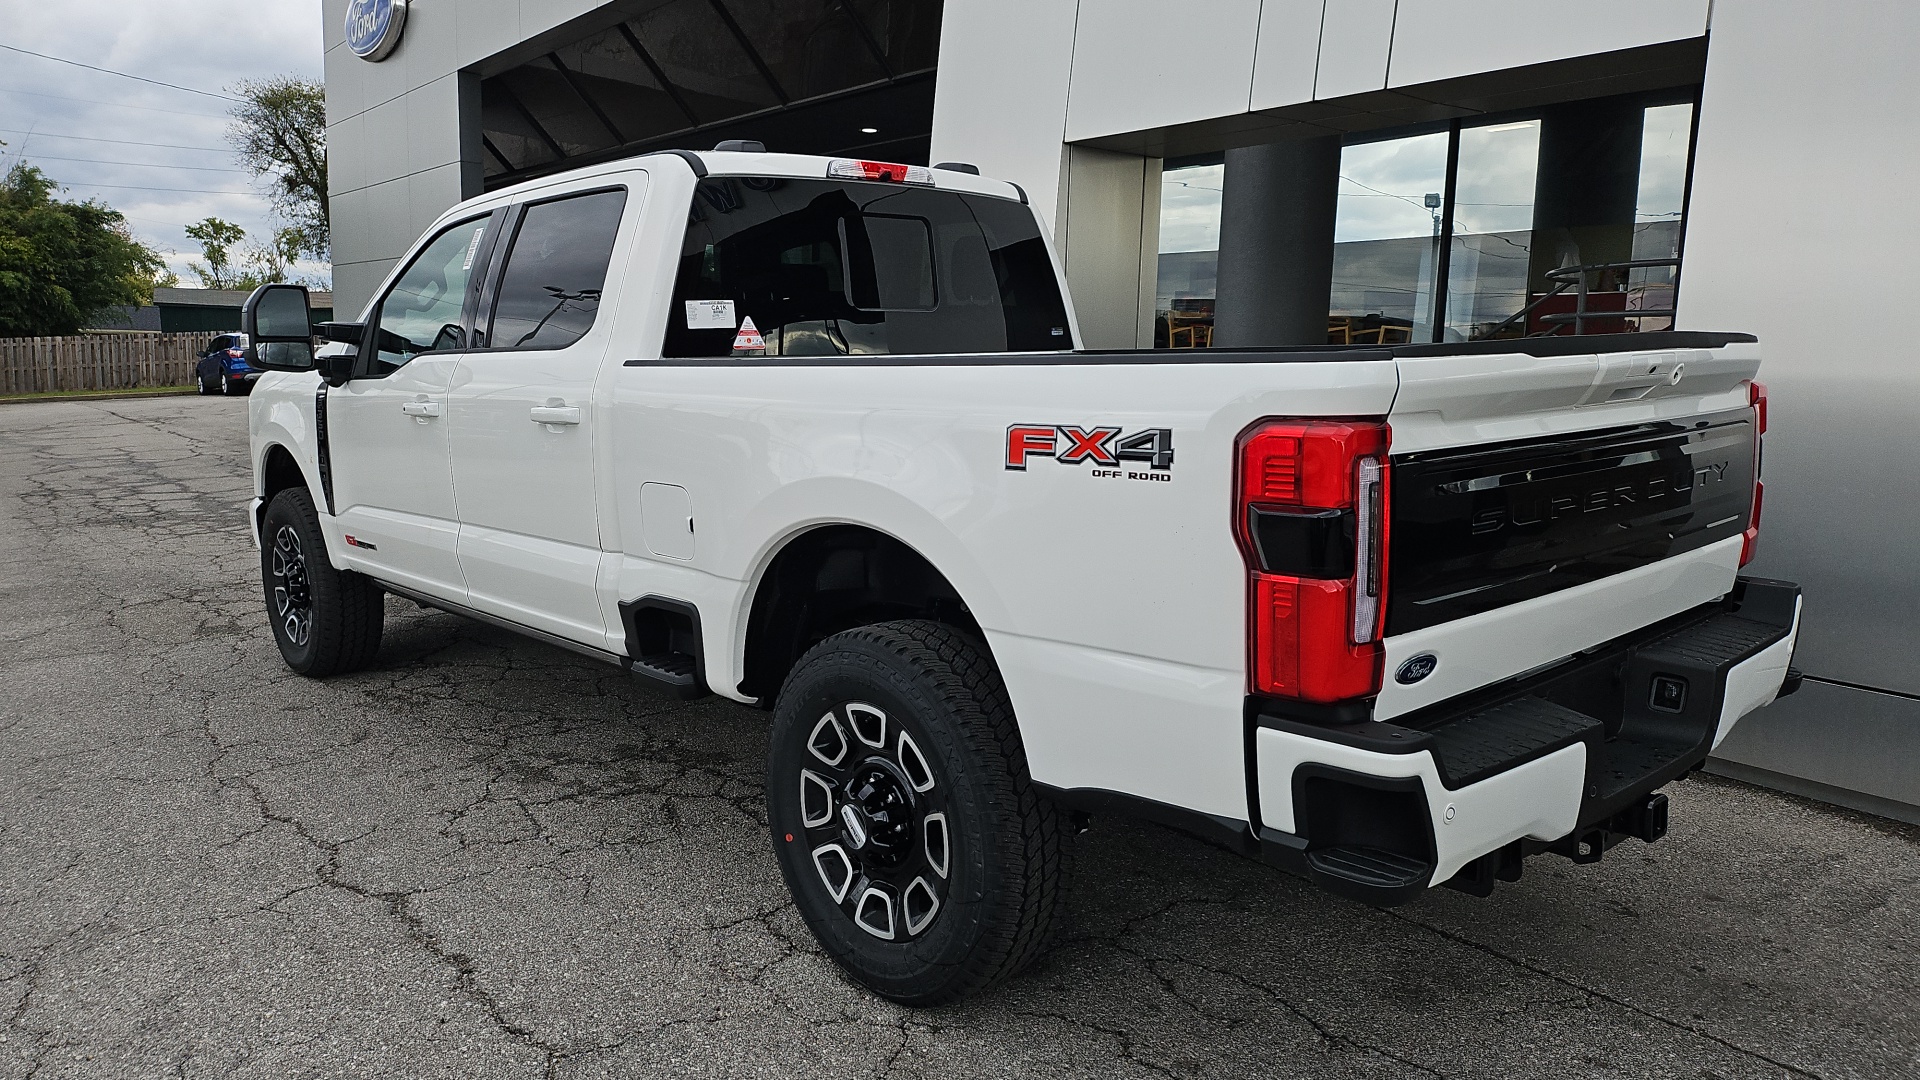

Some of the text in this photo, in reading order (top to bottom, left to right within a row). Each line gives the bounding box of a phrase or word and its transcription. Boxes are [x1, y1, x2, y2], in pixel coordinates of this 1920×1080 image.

[350, 0, 379, 43] Ford
[1004, 423, 1175, 472] FX4
[1092, 469, 1171, 482] OFF ROAD
[1472, 460, 1729, 536] SUPER DUTY
[1407, 660, 1431, 678] Ford
